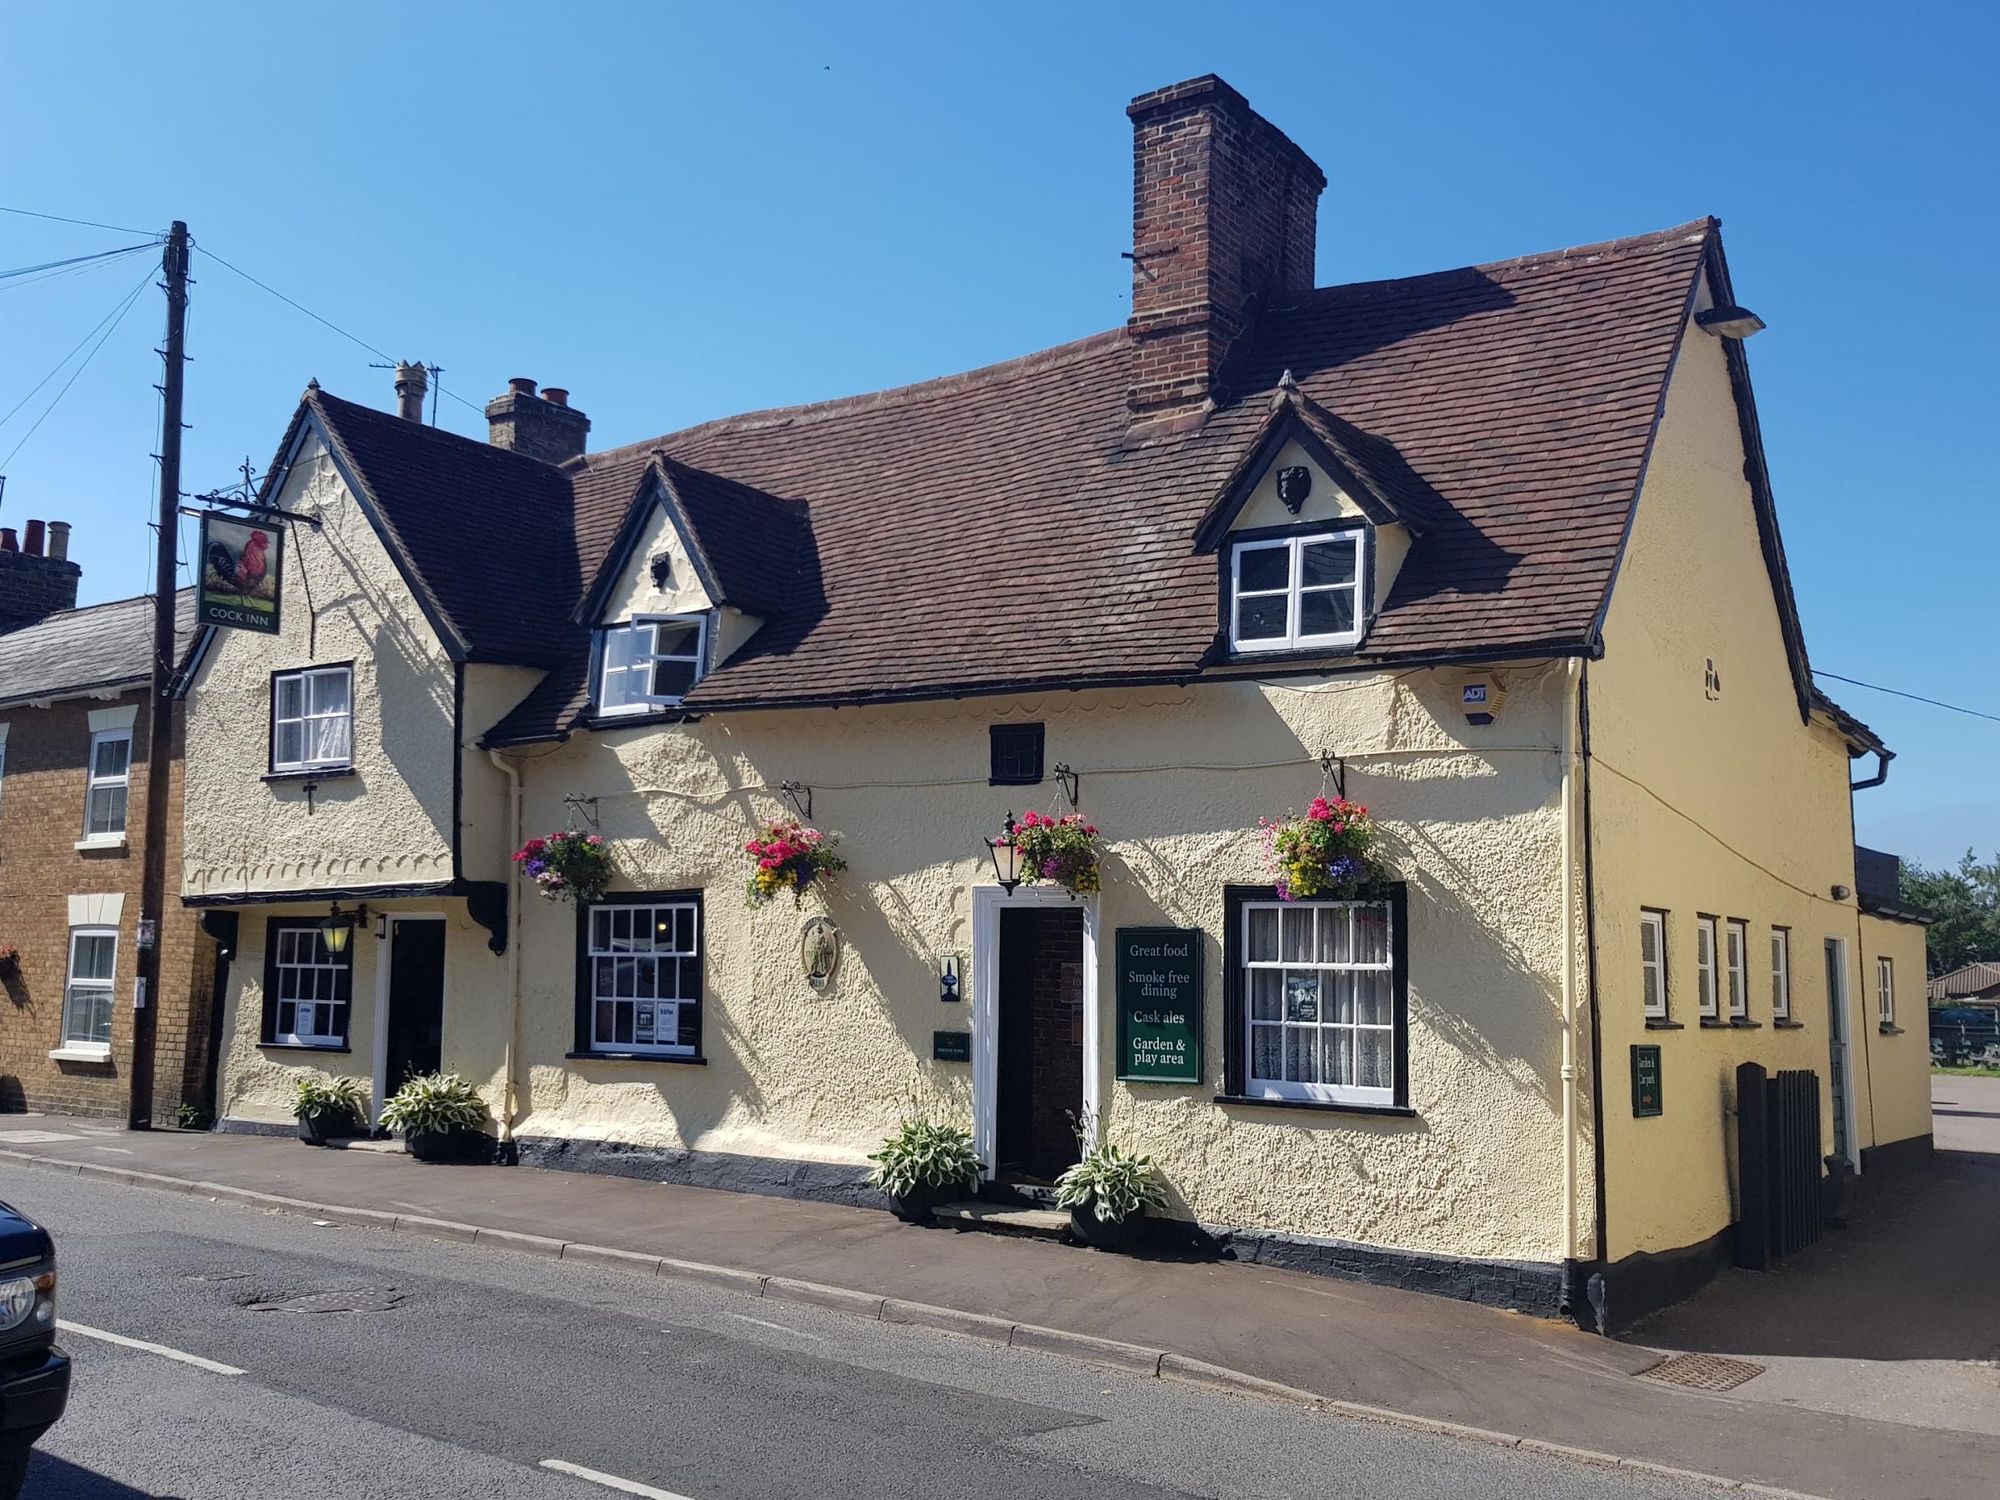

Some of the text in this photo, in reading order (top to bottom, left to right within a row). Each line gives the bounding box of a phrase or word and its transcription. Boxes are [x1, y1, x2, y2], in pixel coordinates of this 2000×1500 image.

[210, 607, 269, 626] COCK INN
[1464, 687, 1486, 700] ADT
[1130, 943, 1188, 957] Great food
[1128, 970, 1190, 984] Smoke free
[1141, 983, 1178, 1000] dining
[1133, 1010, 1185, 1024] Cask ales
[1132, 1037, 1186, 1051] Garden &
[1134, 1050, 1184, 1066] play area
